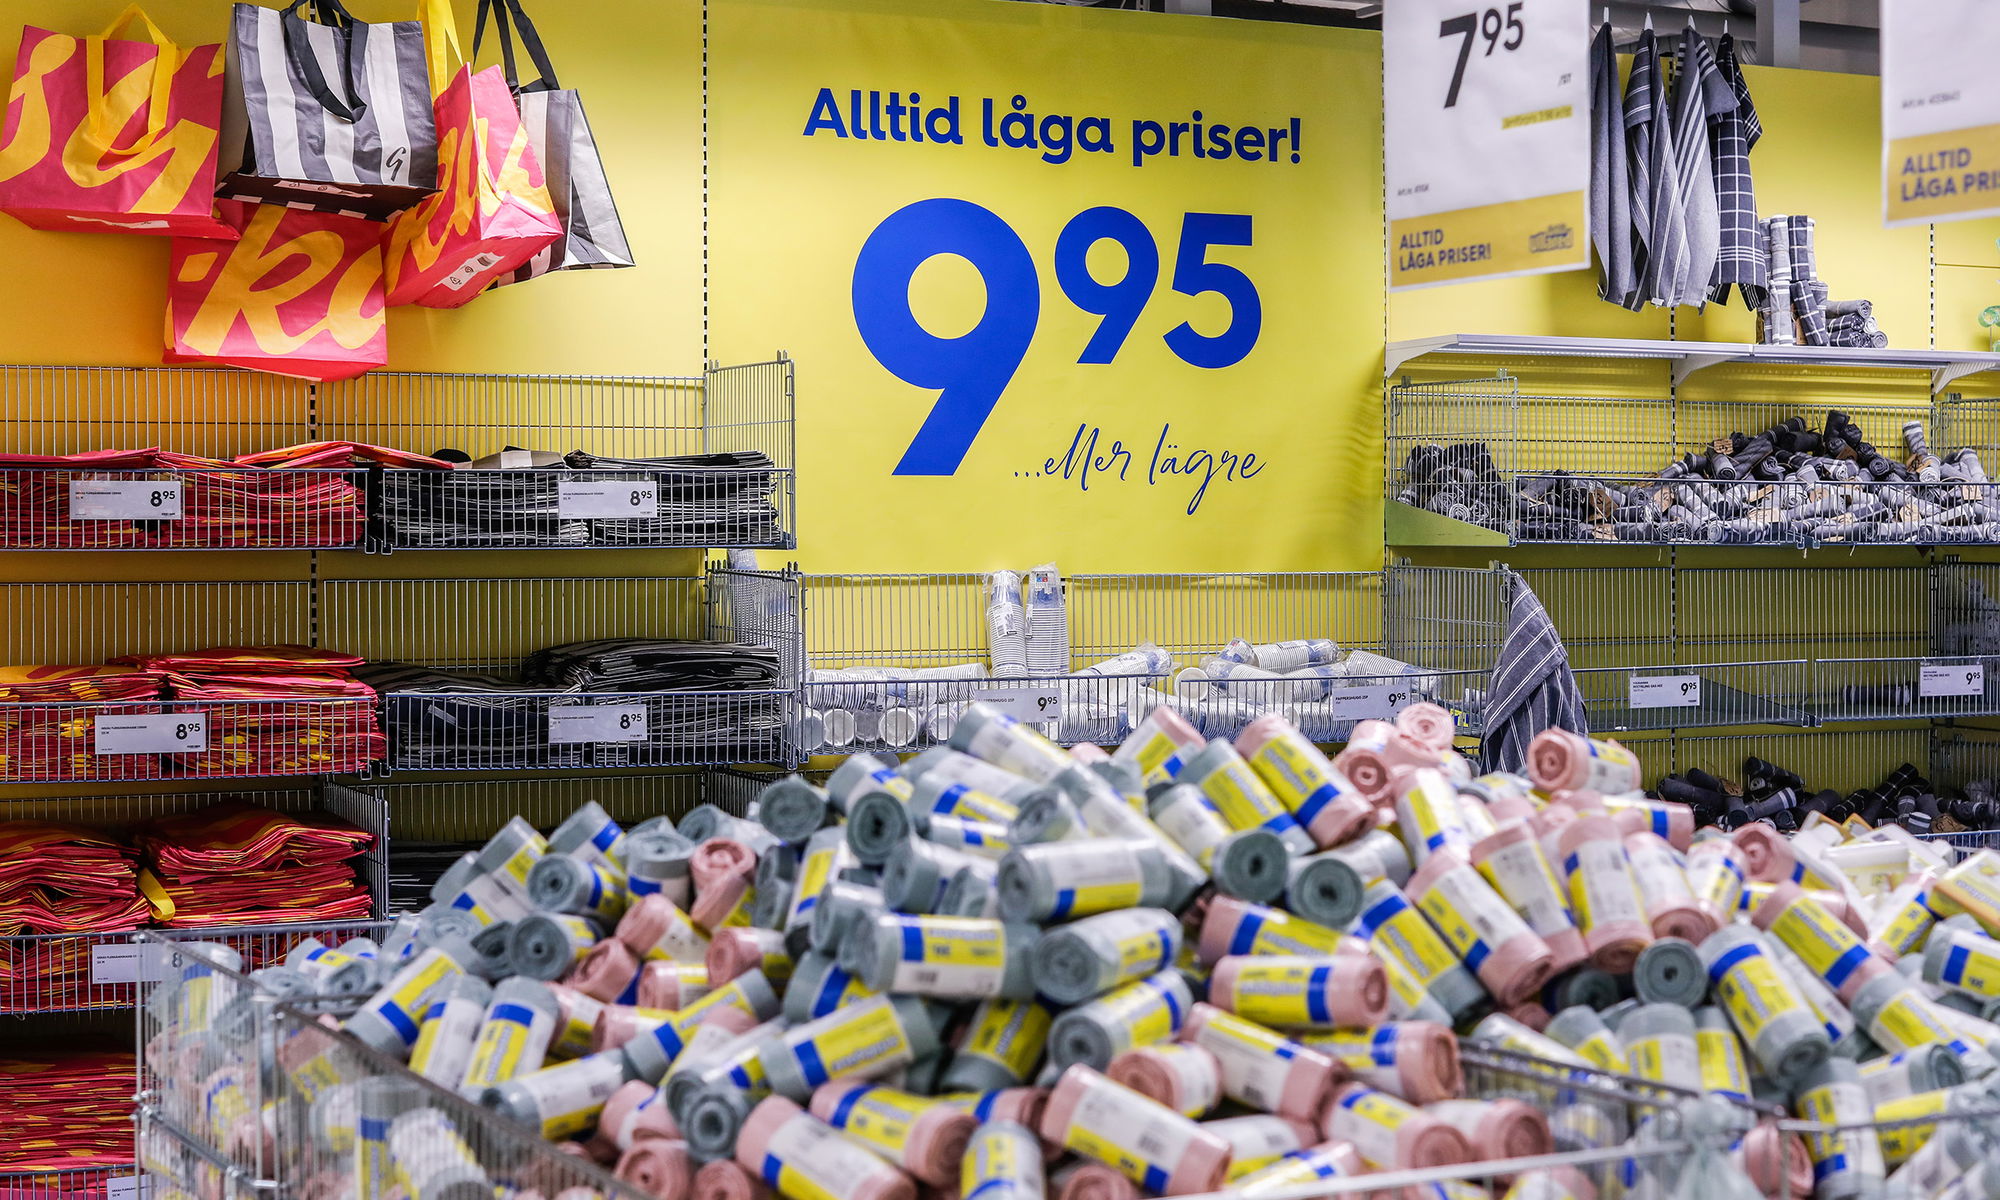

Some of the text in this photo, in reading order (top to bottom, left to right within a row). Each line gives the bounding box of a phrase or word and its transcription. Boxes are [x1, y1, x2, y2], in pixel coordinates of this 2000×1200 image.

[803, 88, 1302, 167] Alltid låga priser!
[1902, 148, 1972, 176] ALLTID
[1901, 176, 1957, 203] LÅGA
[1400, 229, 1444, 250] ALLTID
[1399, 243, 1492, 272] LÅGA PRISER!
[1147, 423, 1267, 516] lägre
